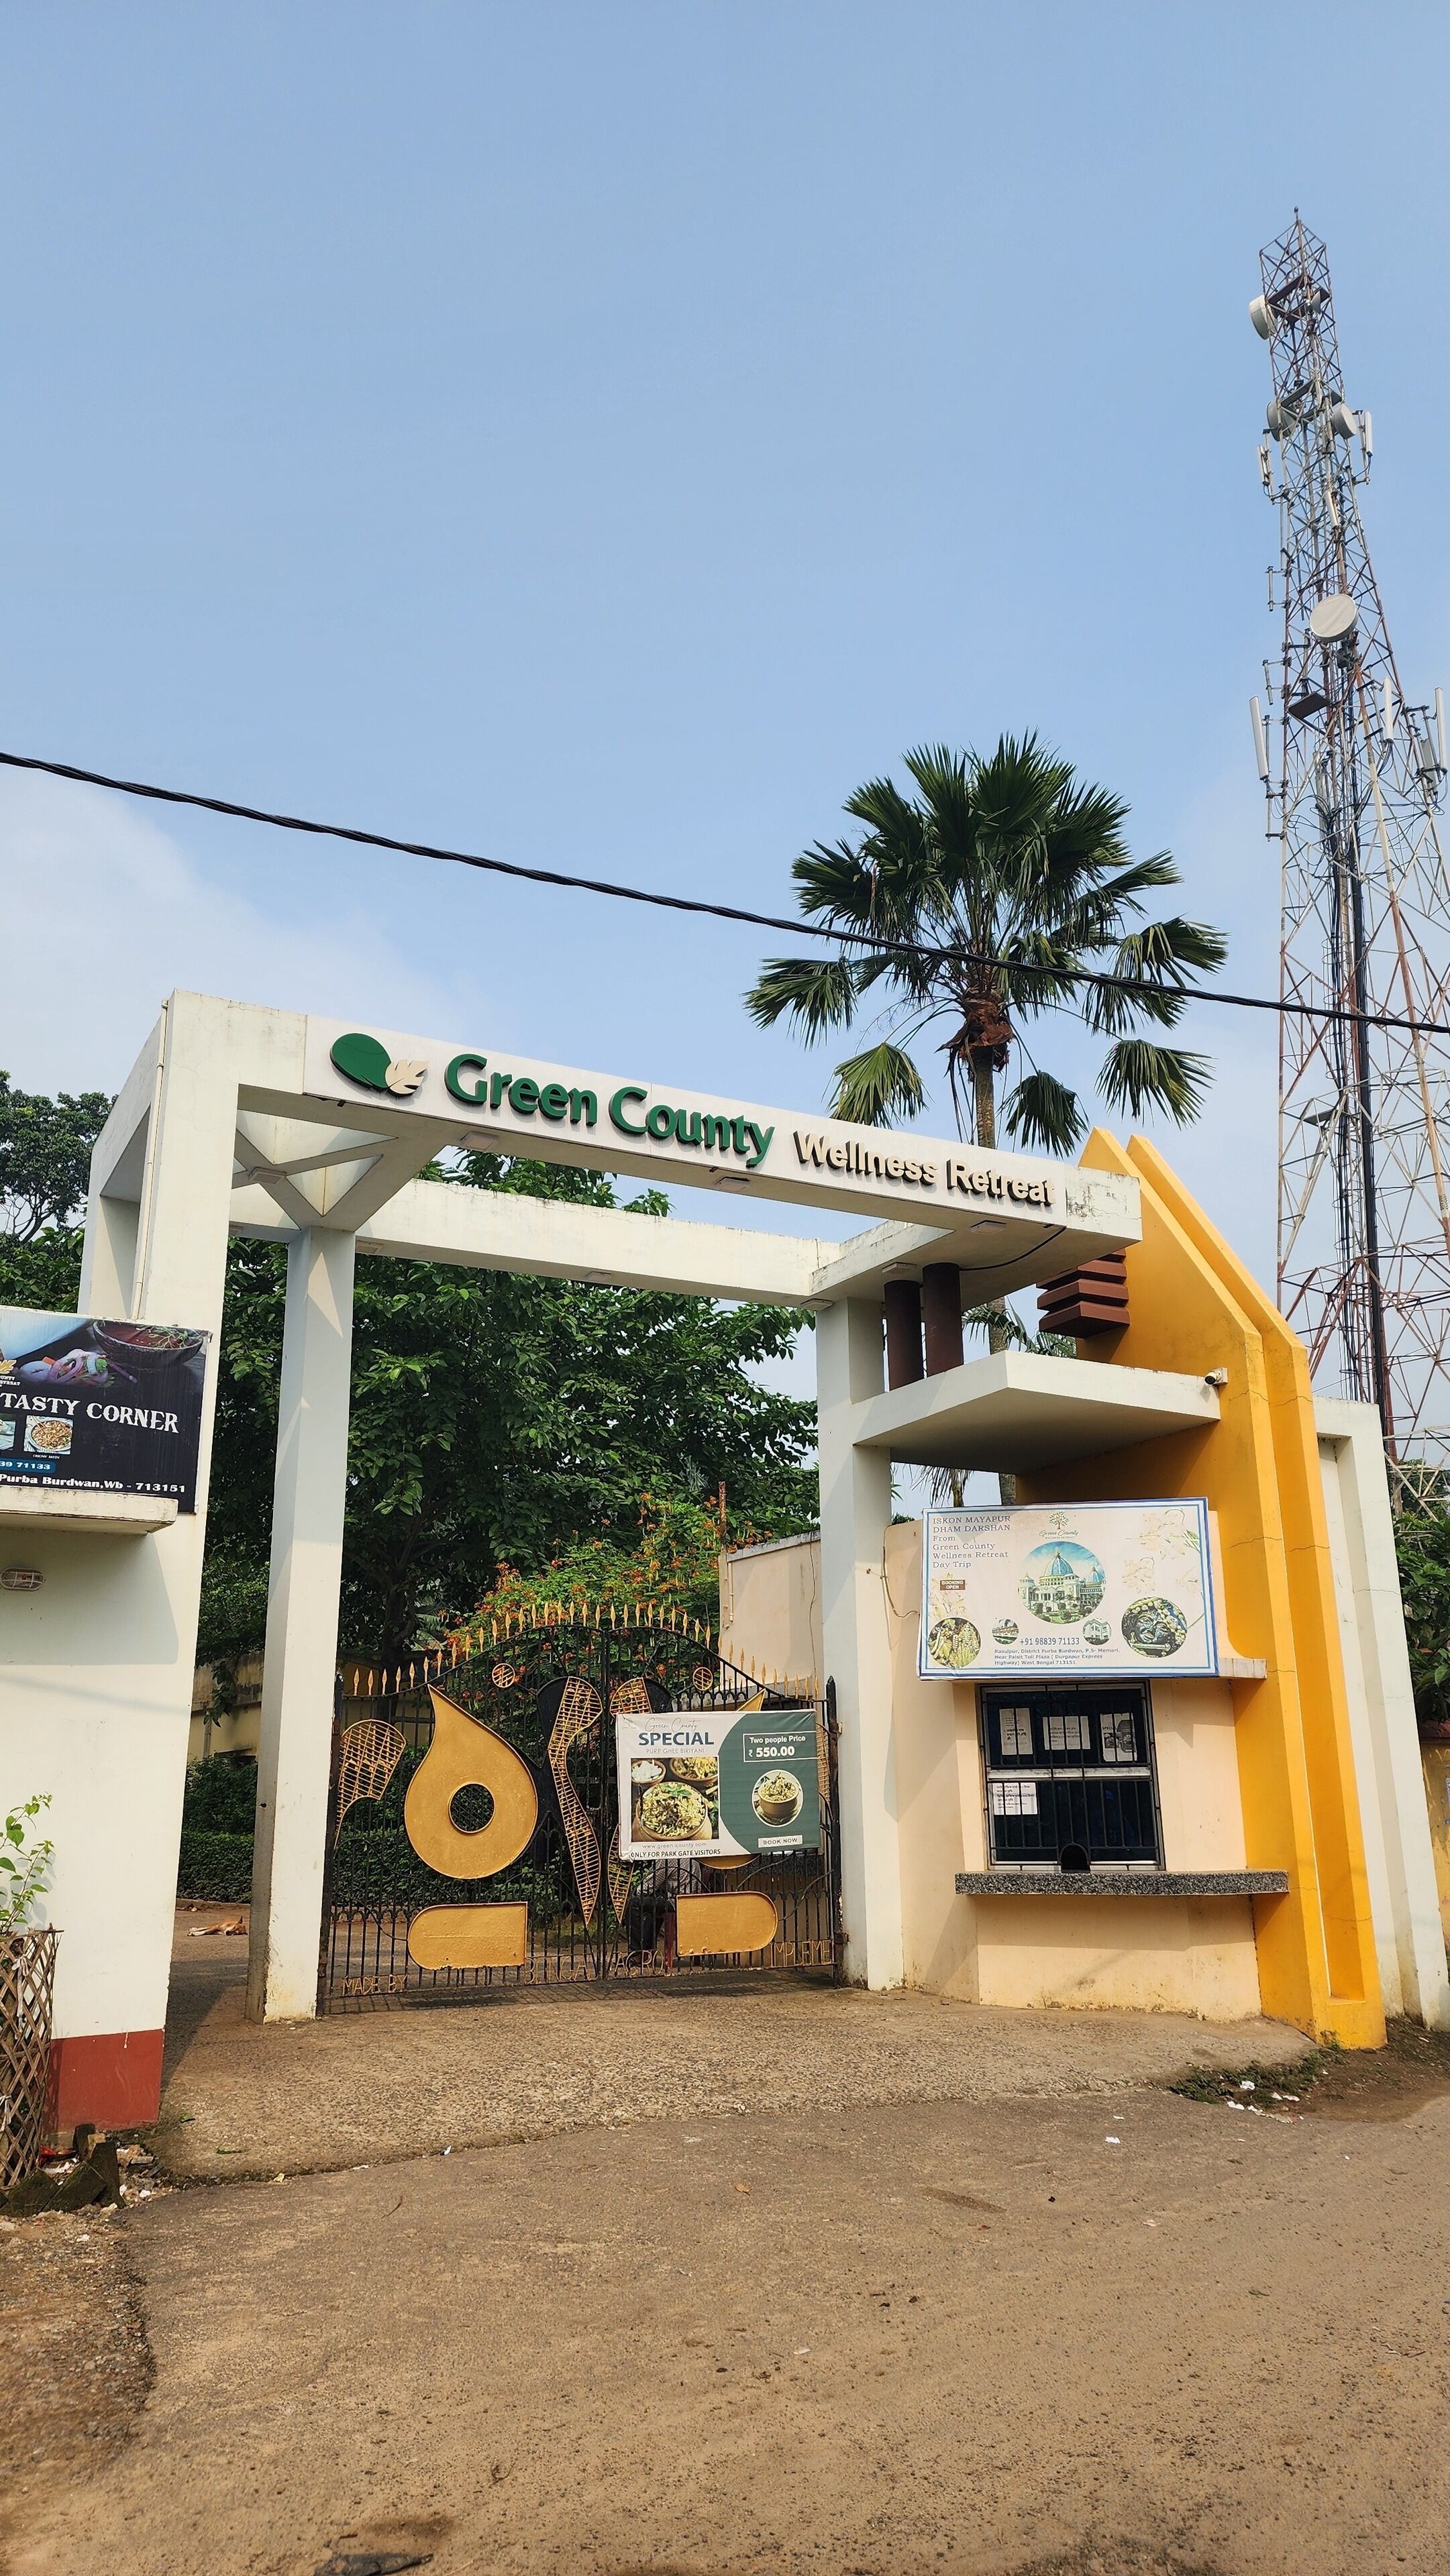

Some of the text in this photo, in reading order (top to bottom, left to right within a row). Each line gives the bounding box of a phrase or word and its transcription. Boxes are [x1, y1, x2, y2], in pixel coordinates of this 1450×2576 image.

[444, 1053, 1055, 1206] Green County Wellness Retreat
[0, 1393, 179, 1433] TASTY CORNER
[0, 1474, 38, 1484] Purba
[135, 1483, 185, 1493] 713151
[1035, 1638, 1056, 1646] 98839
[645, 1717, 701, 1733] Green County
[639, 1732, 714, 1746] SPECIAL
[765, 1736, 787, 1744] people
[756, 1746, 795, 1758] 550.00
[342, 1976, 381, 1996] MADE
[389, 1974, 408, 1992] BY
